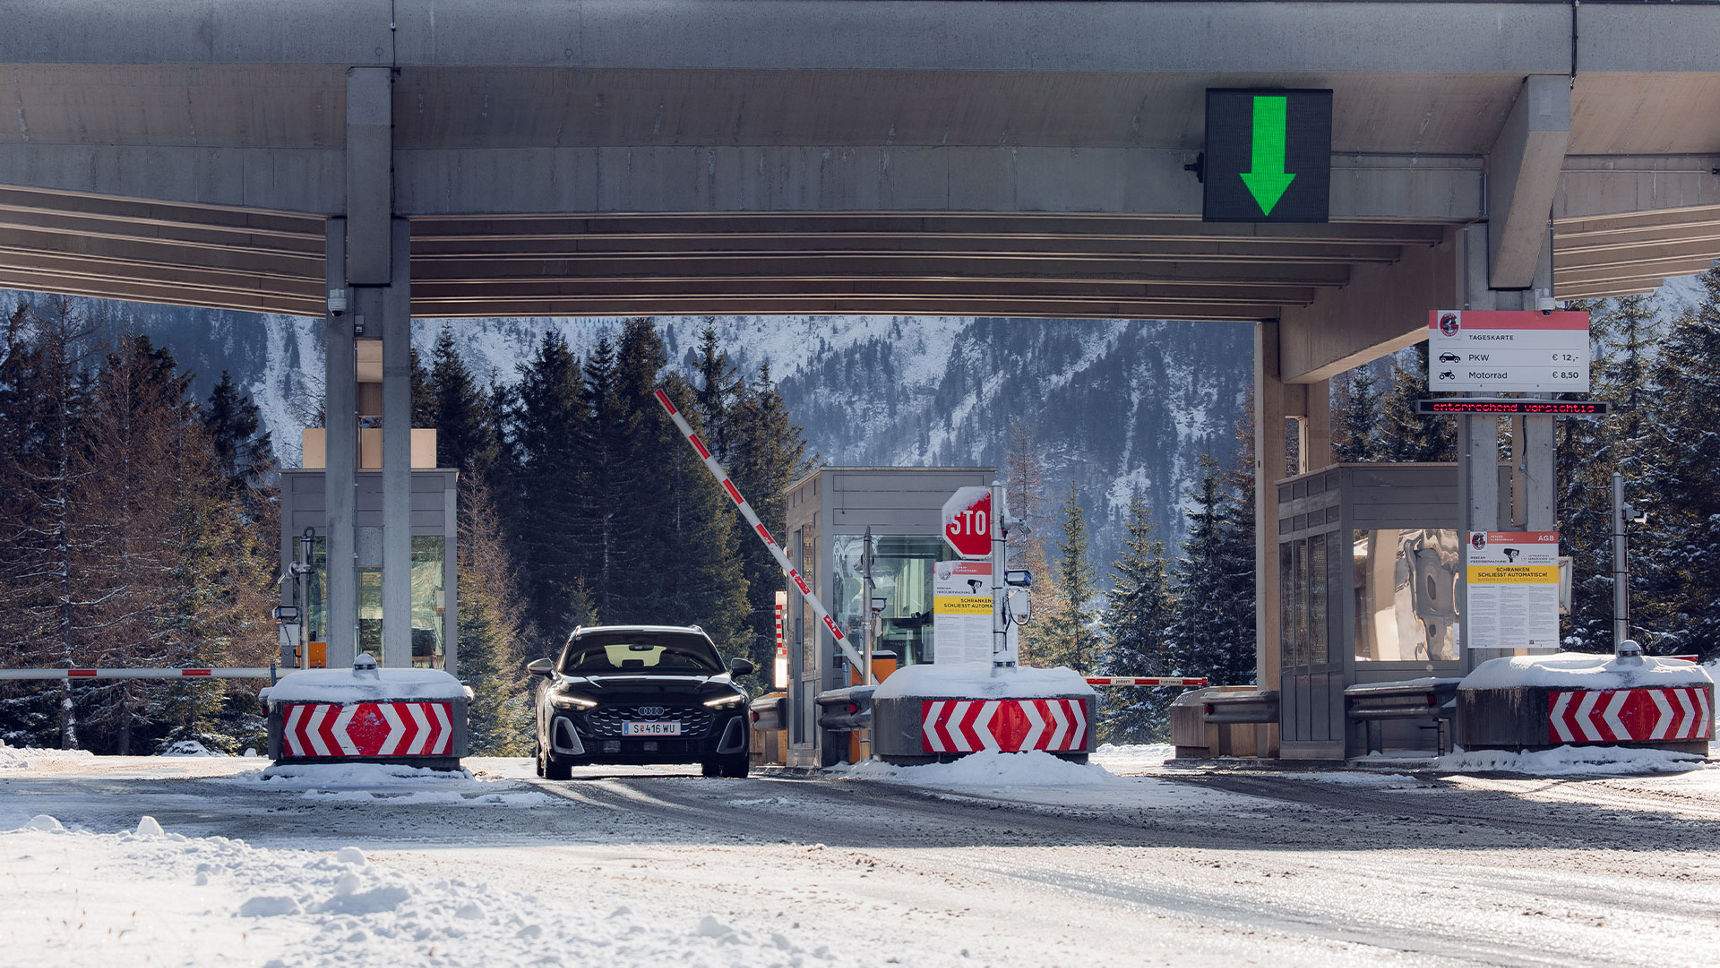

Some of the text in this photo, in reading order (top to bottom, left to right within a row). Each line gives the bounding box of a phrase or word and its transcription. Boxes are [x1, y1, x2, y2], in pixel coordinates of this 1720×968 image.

[1468, 371, 1579, 380] Motorrad € 8,50
[950, 509, 991, 536] STO
[633, 724, 675, 734] S 416 WU
